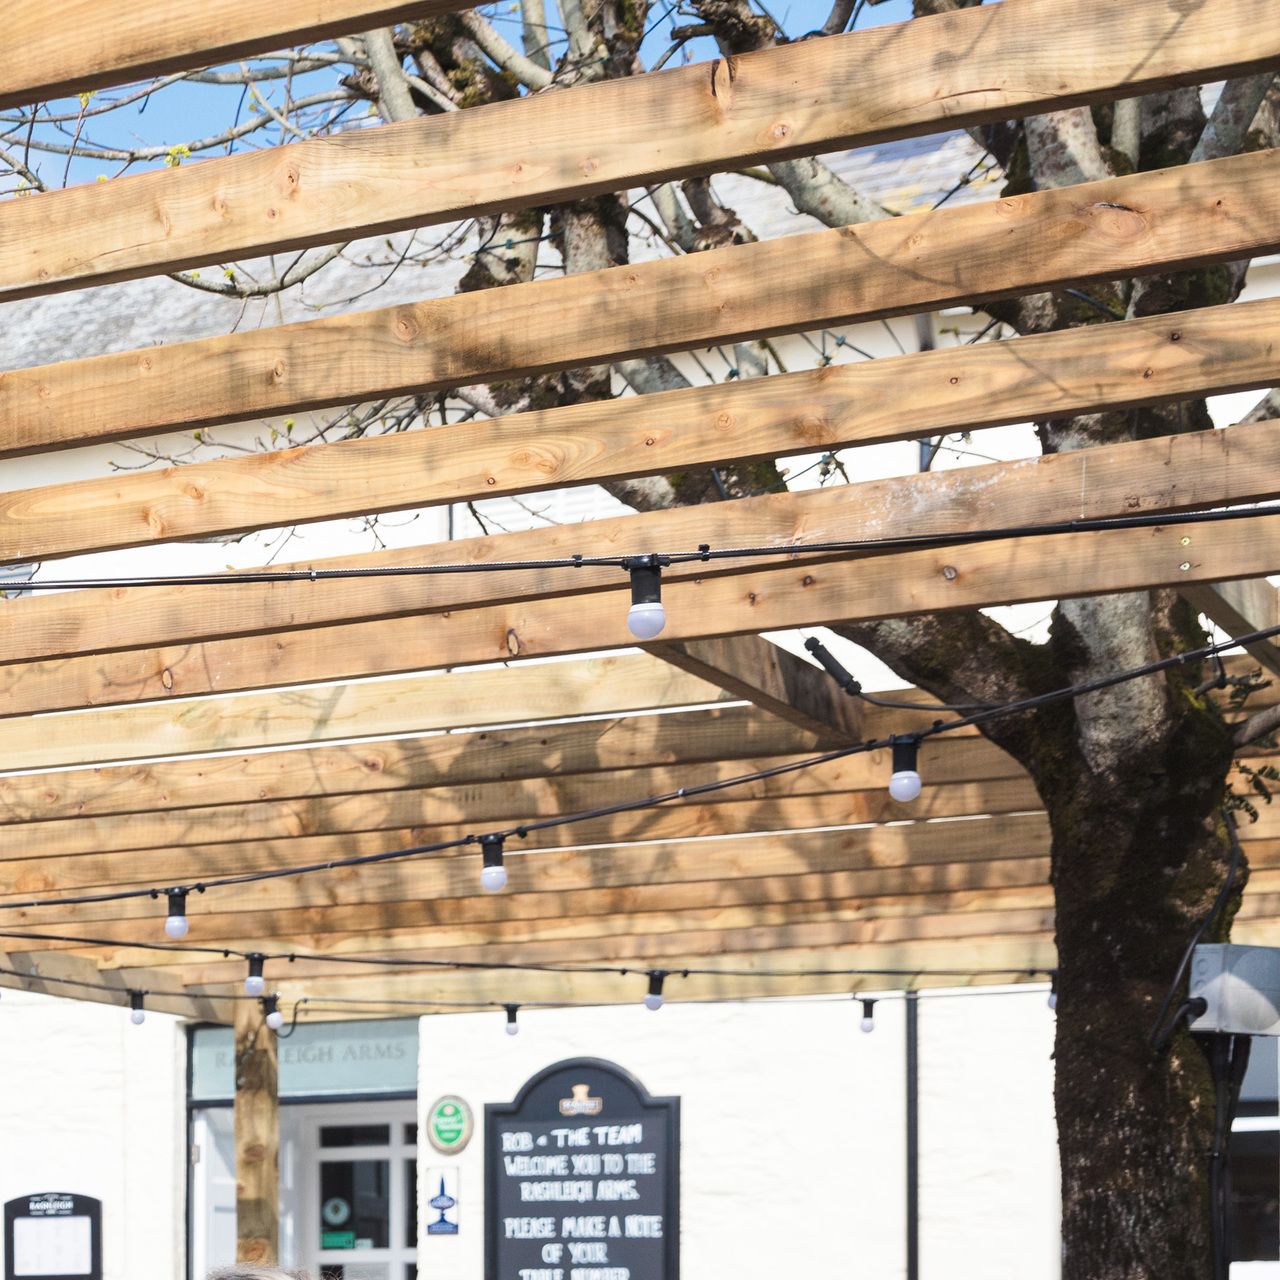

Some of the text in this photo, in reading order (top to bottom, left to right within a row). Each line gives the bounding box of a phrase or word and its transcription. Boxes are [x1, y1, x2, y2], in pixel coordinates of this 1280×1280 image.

[343, 1042, 408, 1061] ARMS
[501, 1132, 534, 1152] ROB
[550, 1127, 590, 1148] THE
[592, 1123, 643, 1145] TEAM
[504, 1153, 656, 1176] WELCOME YOU TO THE
[520, 1180, 594, 1203] RASHLEIGH
[503, 1214, 663, 1239] PLEASE MAKE A NOTE
[541, 1242, 609, 1264] OF YOUR
